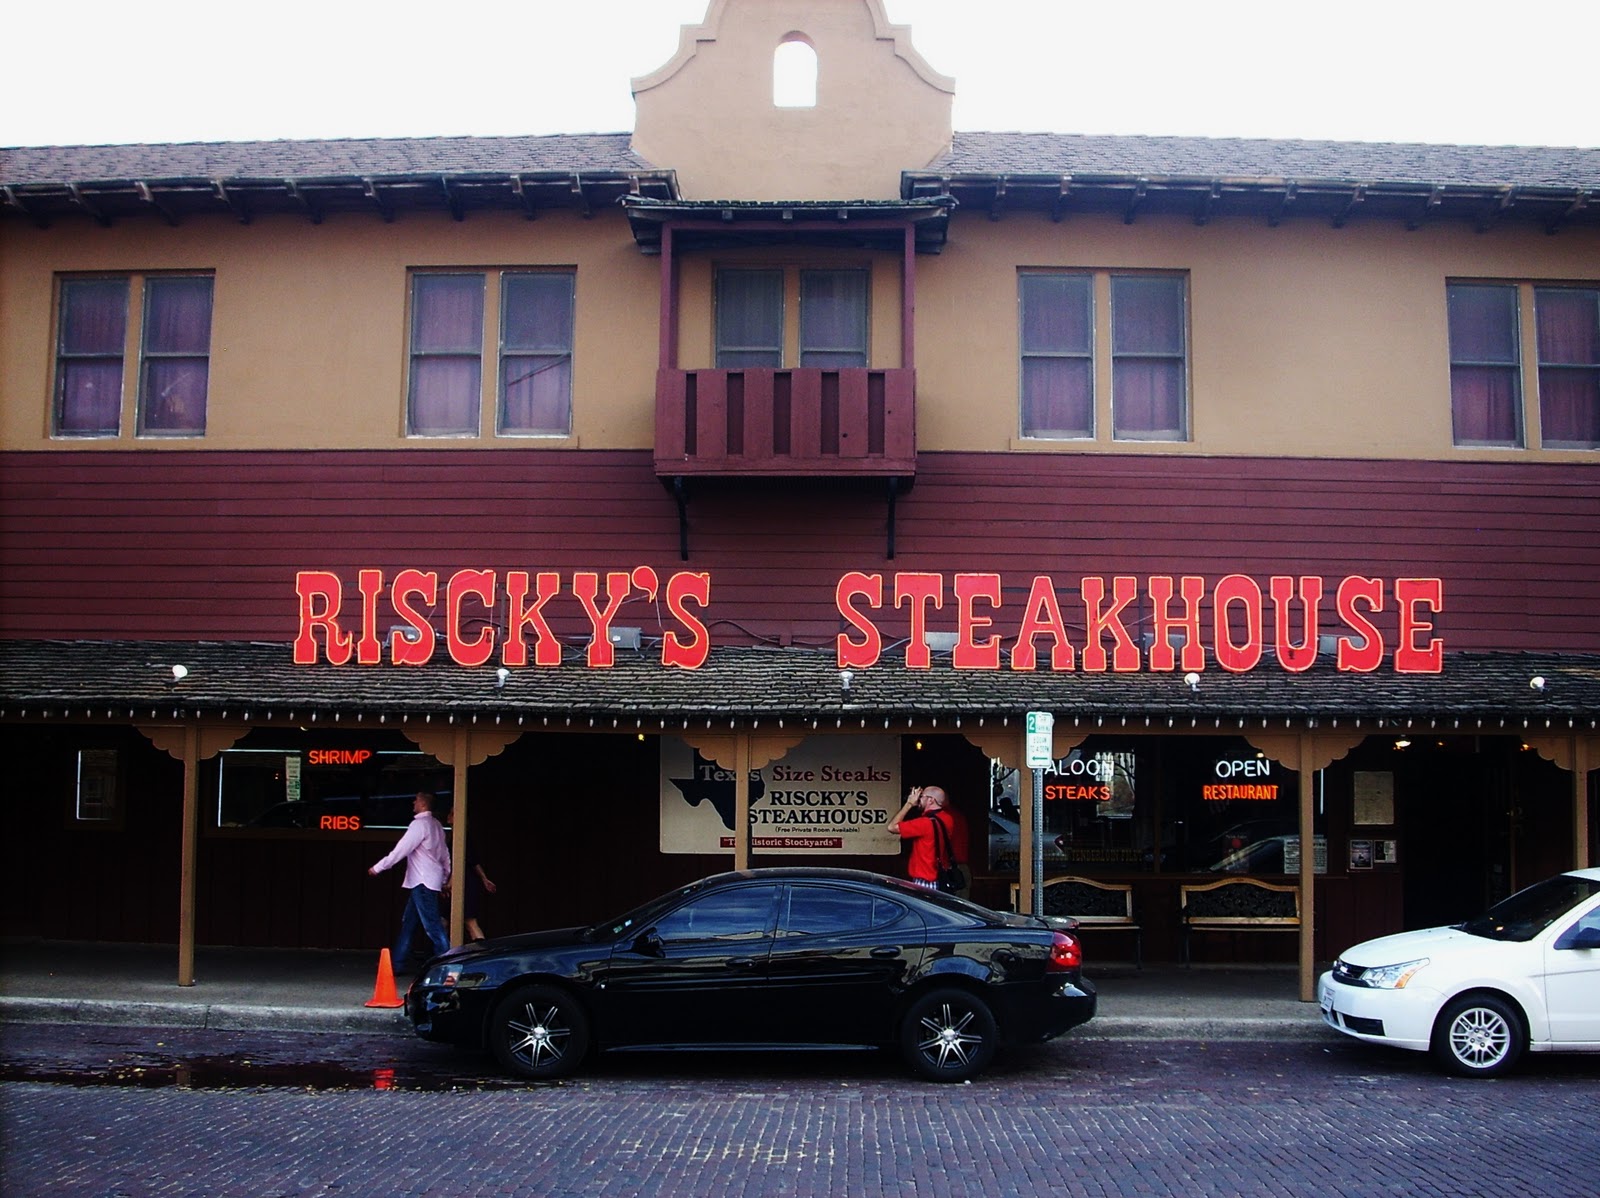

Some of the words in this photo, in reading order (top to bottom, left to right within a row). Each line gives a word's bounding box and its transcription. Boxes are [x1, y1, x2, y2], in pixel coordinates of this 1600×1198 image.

[293, 565, 711, 669] RISCKY'S
[835, 571, 1444, 674] STEAKHOUSE
[309, 750, 371, 764] SHRIMP
[700, 765, 760, 781] Texs
[772, 766, 815, 782] Size
[821, 766, 891, 782] Steaks
[1044, 759, 1114, 776] ALOON
[1215, 760, 1270, 777] OPEN
[770, 791, 868, 806] RISCKY'S
[1045, 785, 1110, 800] STEAKS
[1203, 785, 1279, 800] RESTAURANT
[320, 816, 360, 830] RIBS
[749, 809, 888, 824] STEAKHOUSE
[751, 838, 782, 846] istoric
